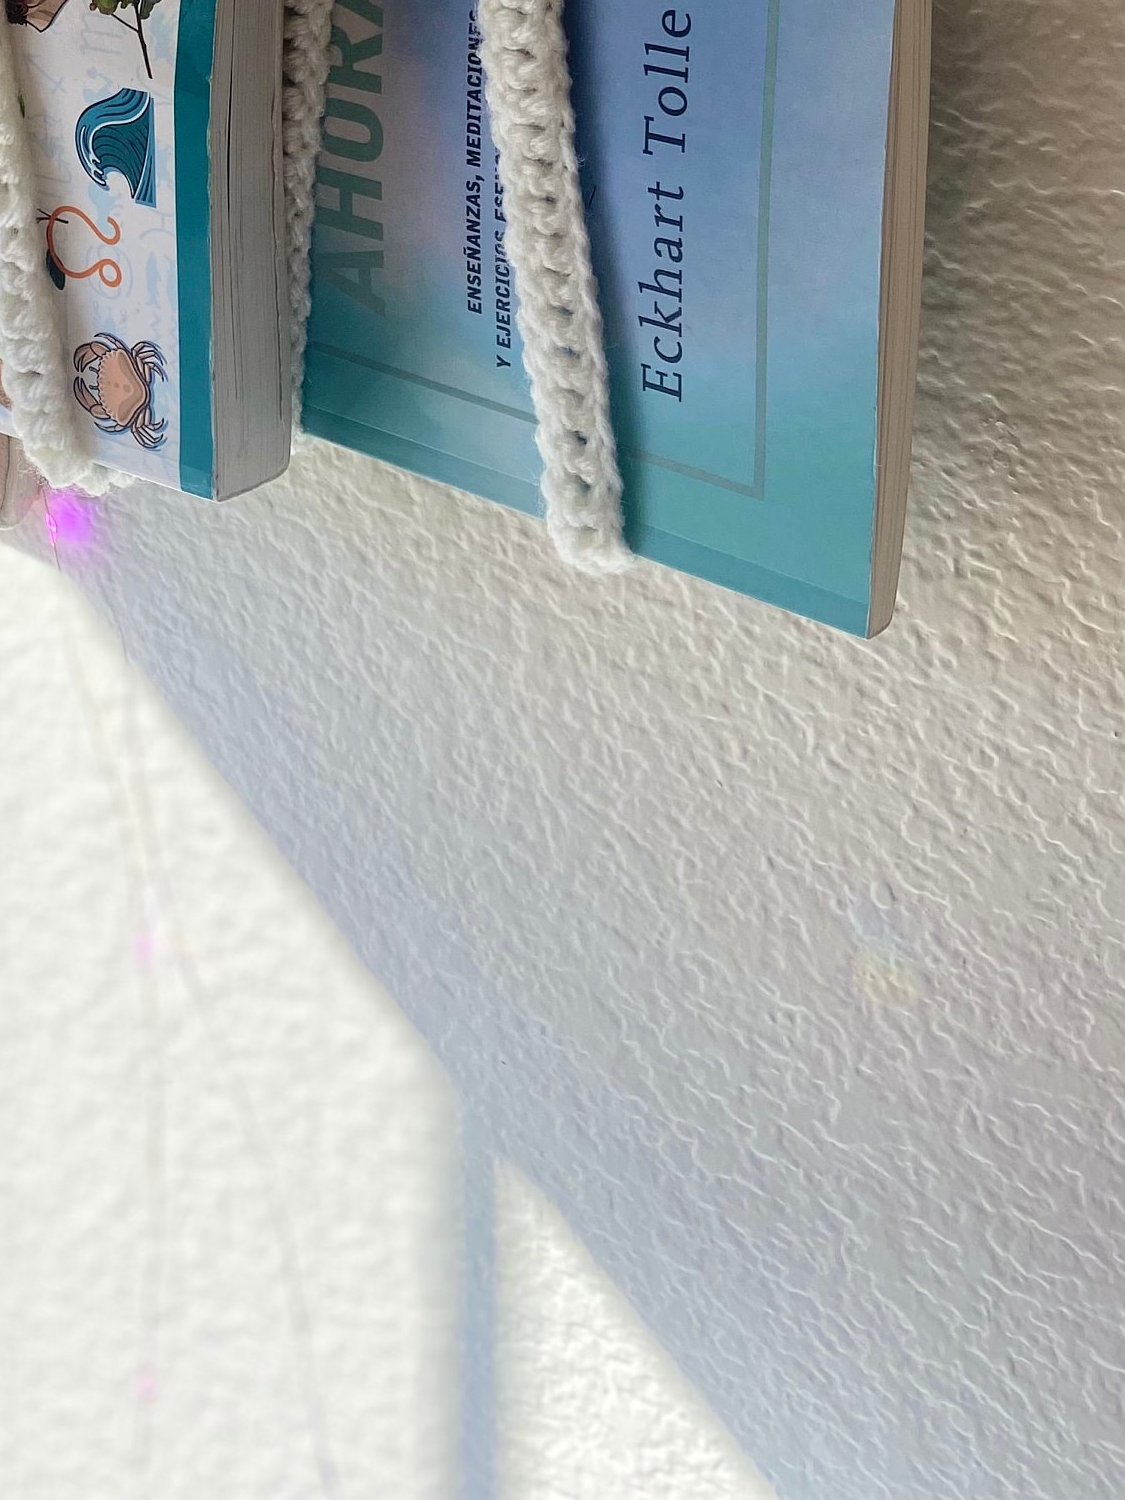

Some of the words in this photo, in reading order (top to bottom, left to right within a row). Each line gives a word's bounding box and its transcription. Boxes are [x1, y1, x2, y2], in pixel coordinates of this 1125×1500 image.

[643, 8, 692, 156] Tolle
[463, 174, 485, 315] ENSEÑANZAS,
[638, 180, 684, 402] Eckhart
[496, 354, 512, 368] Y
